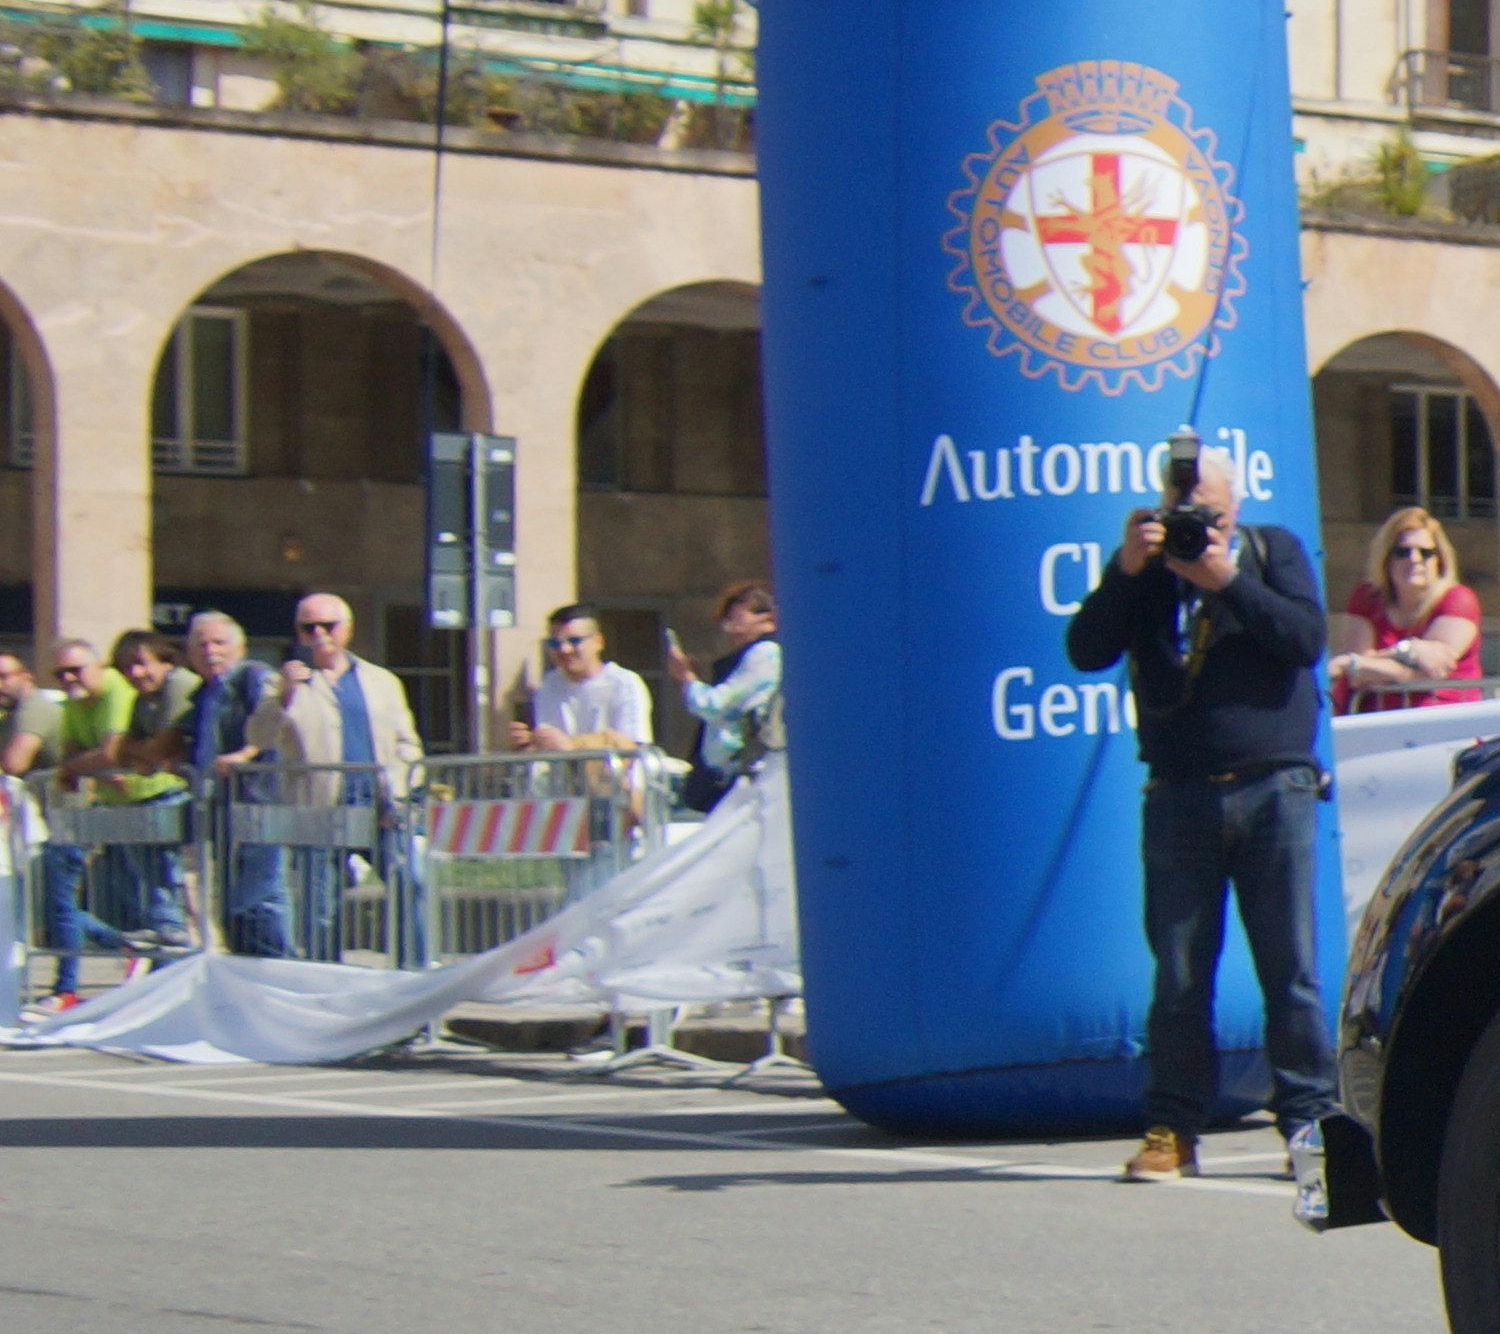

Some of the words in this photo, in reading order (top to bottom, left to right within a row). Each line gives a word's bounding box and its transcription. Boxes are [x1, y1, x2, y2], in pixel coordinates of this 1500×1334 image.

[976, 143, 1077, 355] AUTOMOBILE
[1088, 325, 1182, 361] CLUB
[1185, 150, 1229, 295] GENOVA
